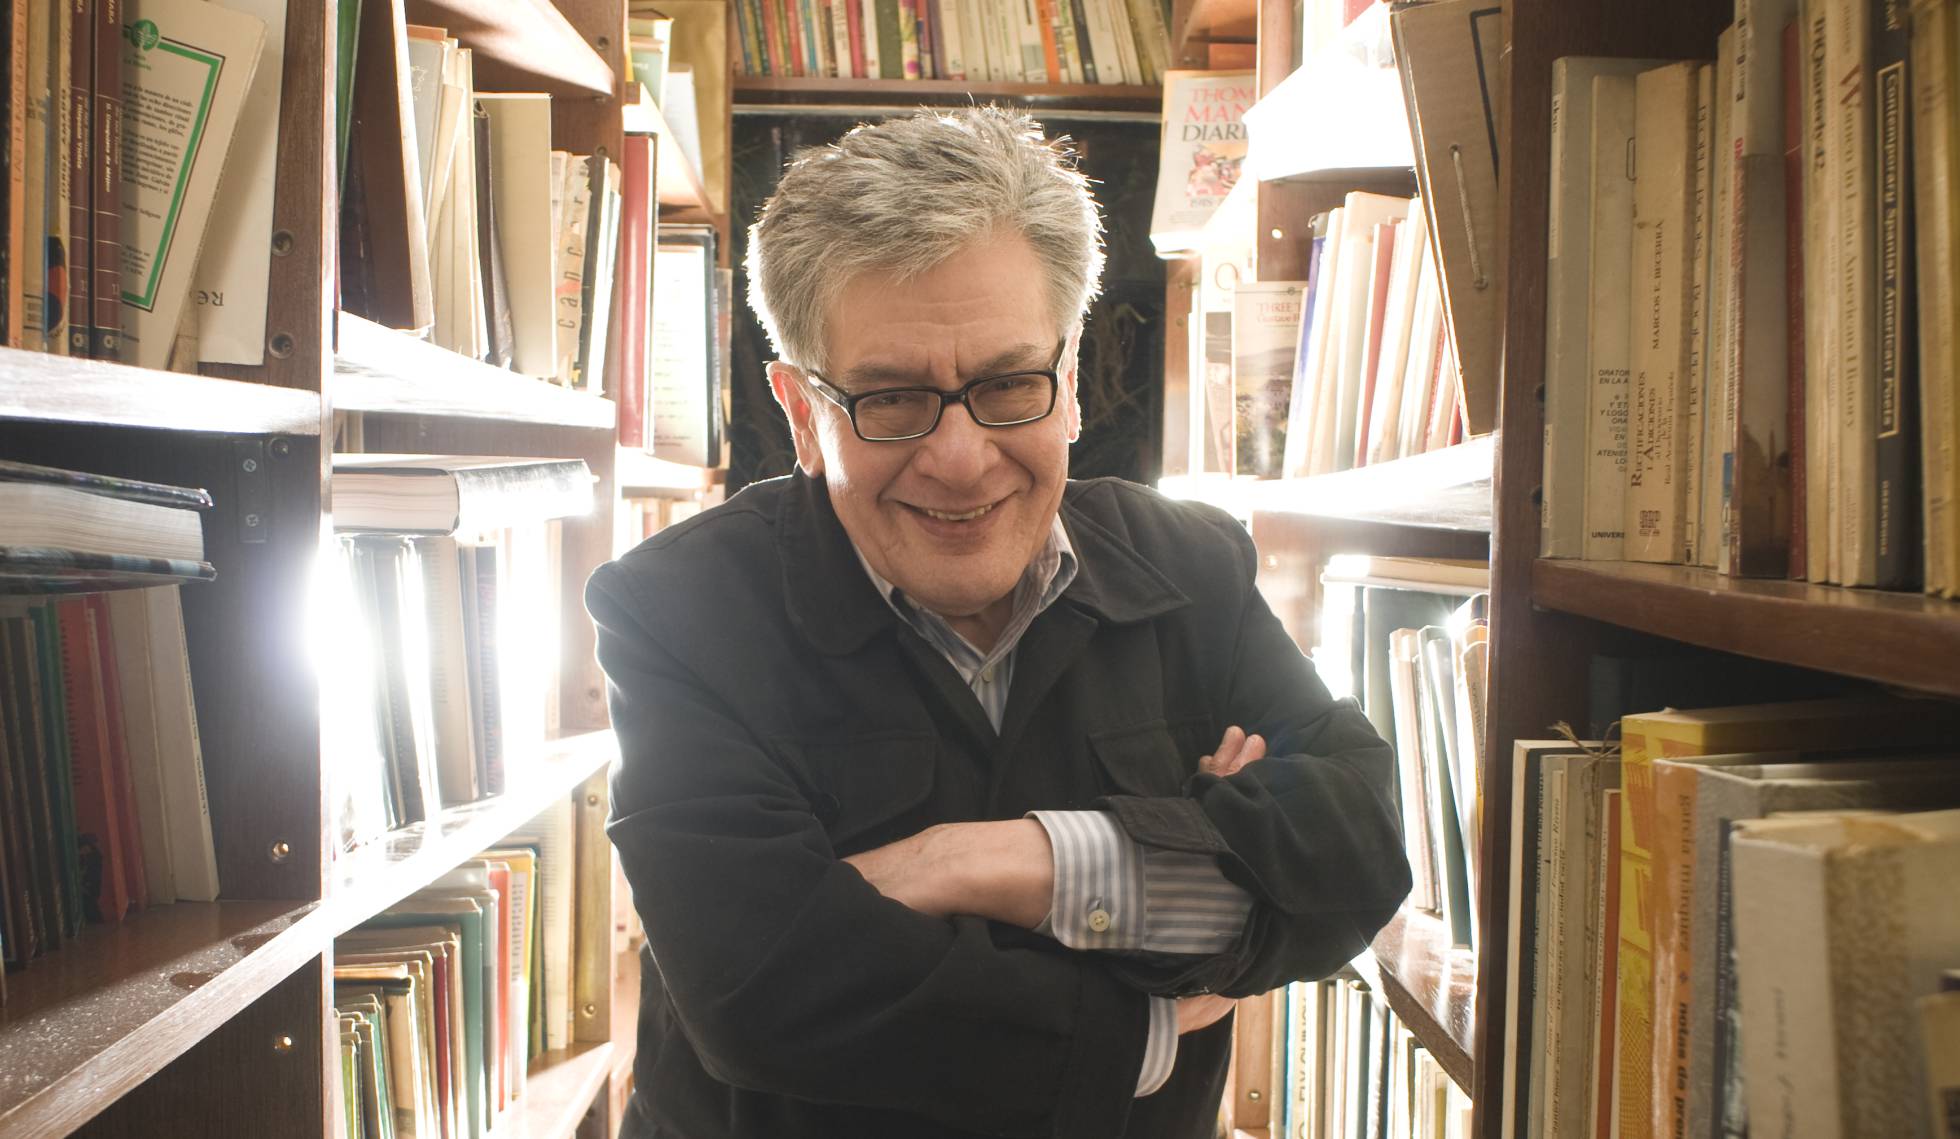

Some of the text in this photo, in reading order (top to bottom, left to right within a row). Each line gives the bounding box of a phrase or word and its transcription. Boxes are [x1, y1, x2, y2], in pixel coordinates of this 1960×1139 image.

[1654, 219, 1664, 279] BECERRA
[1839, 64, 1862, 428] Women in Latin American History
[1882, 73, 1899, 426] Contemporary Spanish American Poets
[1653, 295, 1661, 350] MARCOS
[1631, 372, 1646, 487] RECTIFICACIONES
[1643, 388, 1656, 460] ADICIONES
[1677, 1002, 1689, 1059] notas
